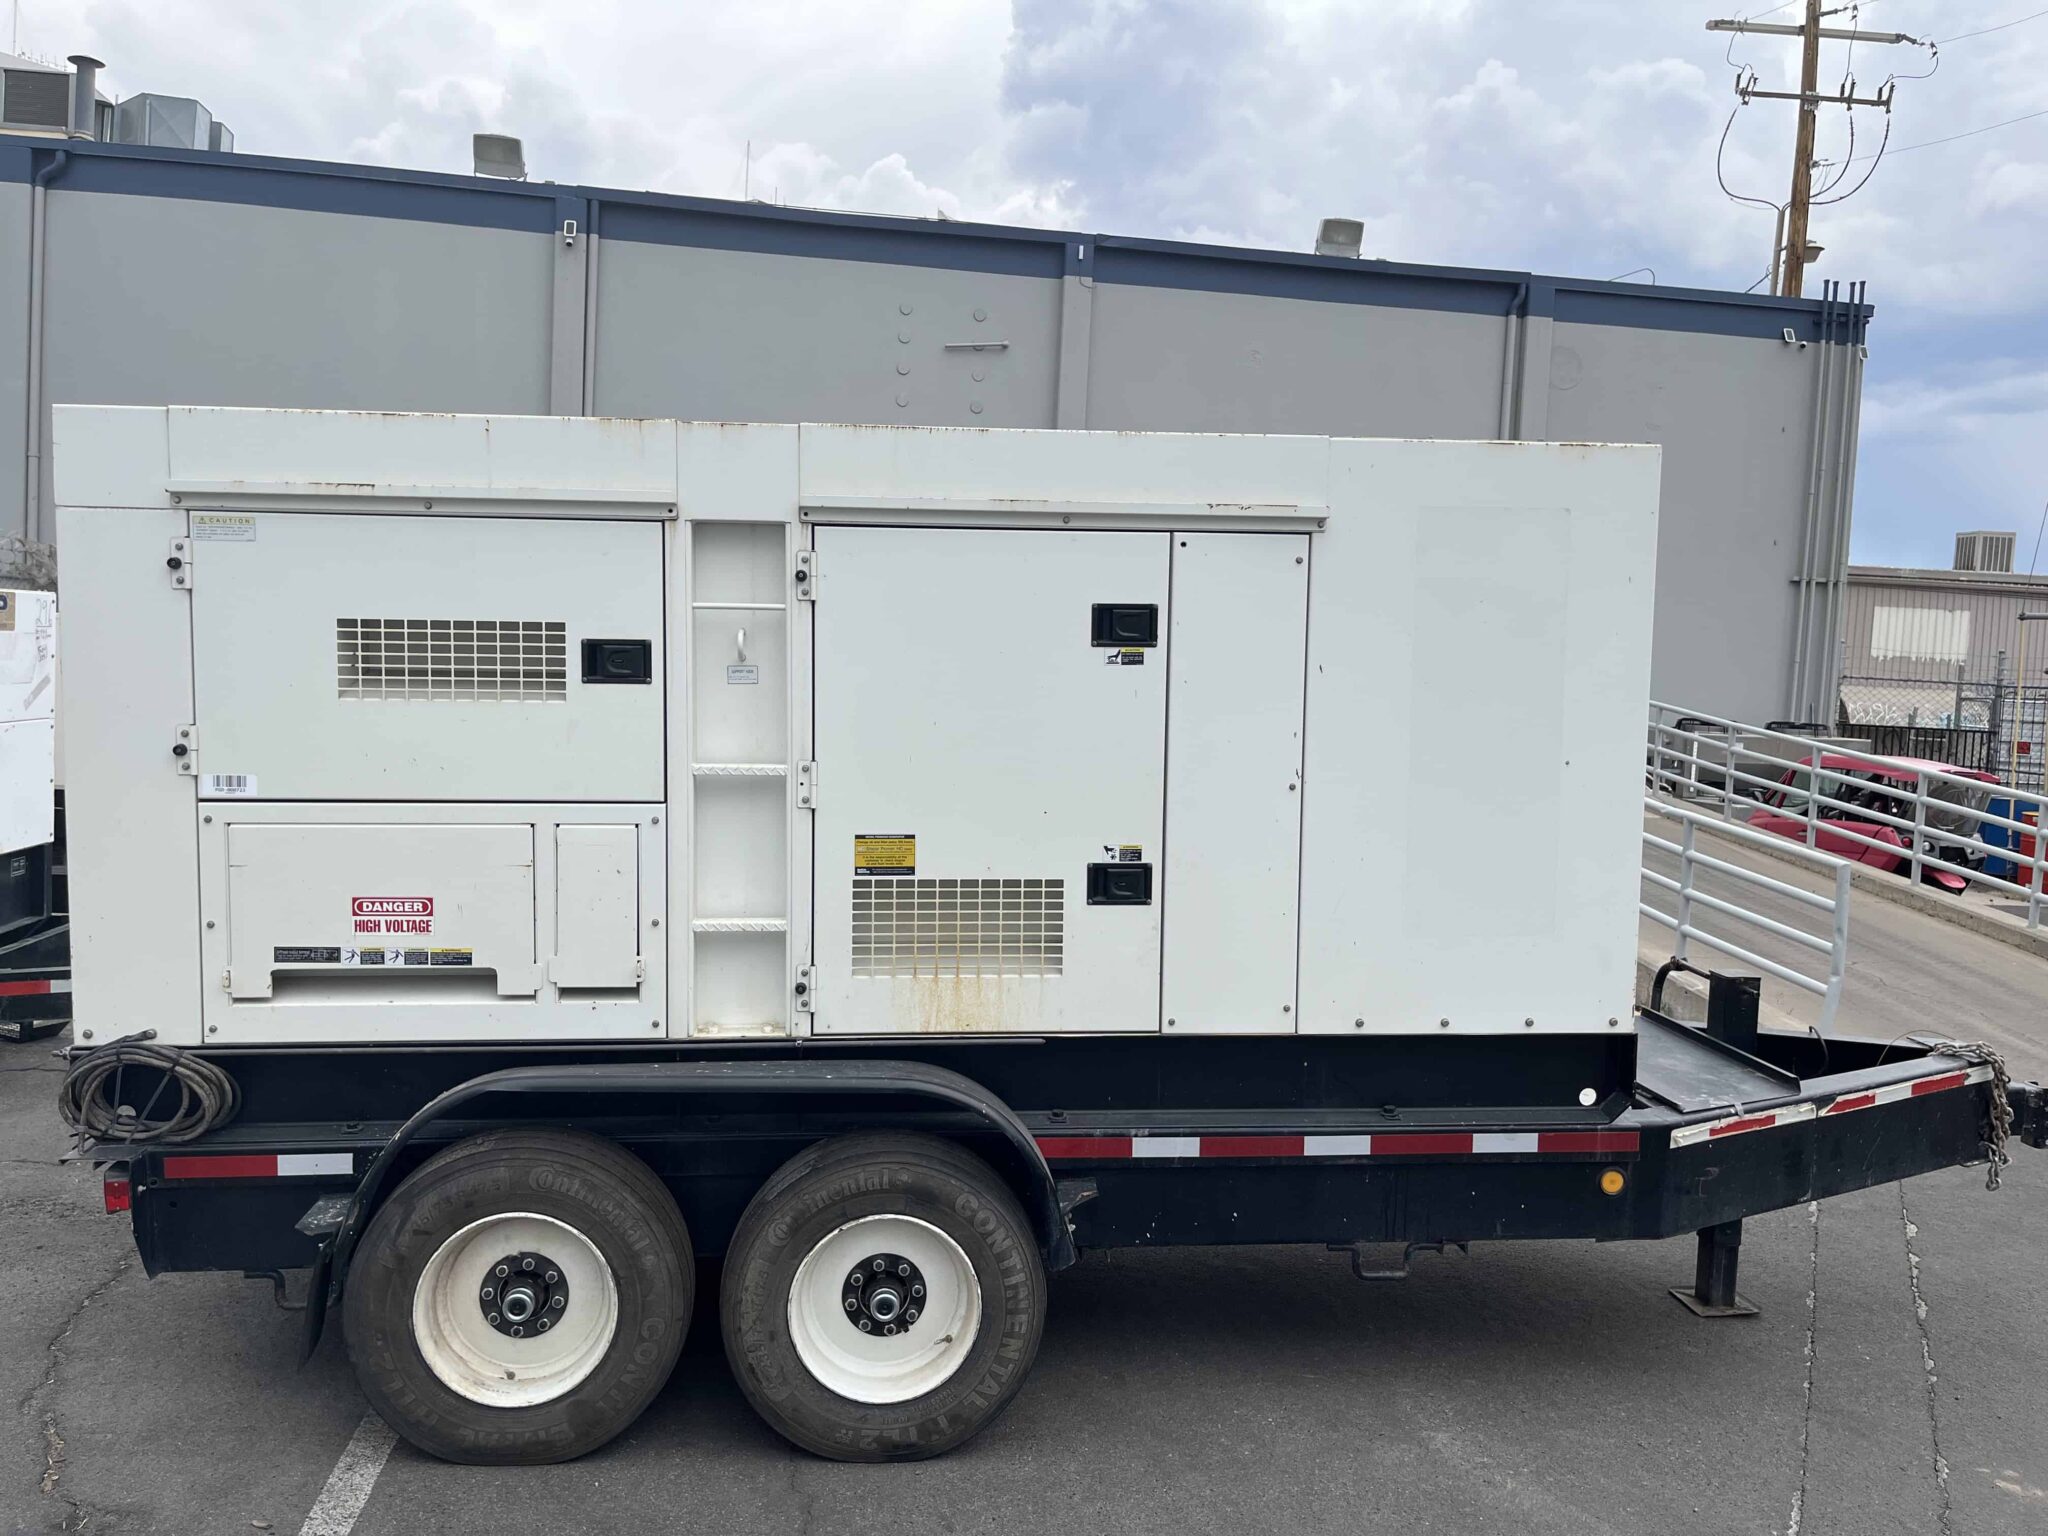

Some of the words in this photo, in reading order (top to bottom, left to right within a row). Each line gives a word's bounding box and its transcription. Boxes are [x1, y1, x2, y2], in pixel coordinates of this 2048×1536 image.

[362, 901, 423, 912] DANGER
[354, 919, 381, 933] HIGH
[385, 919, 432, 933] VOLTAGE
[953, 1193, 1029, 1410] CONTINENTAL
